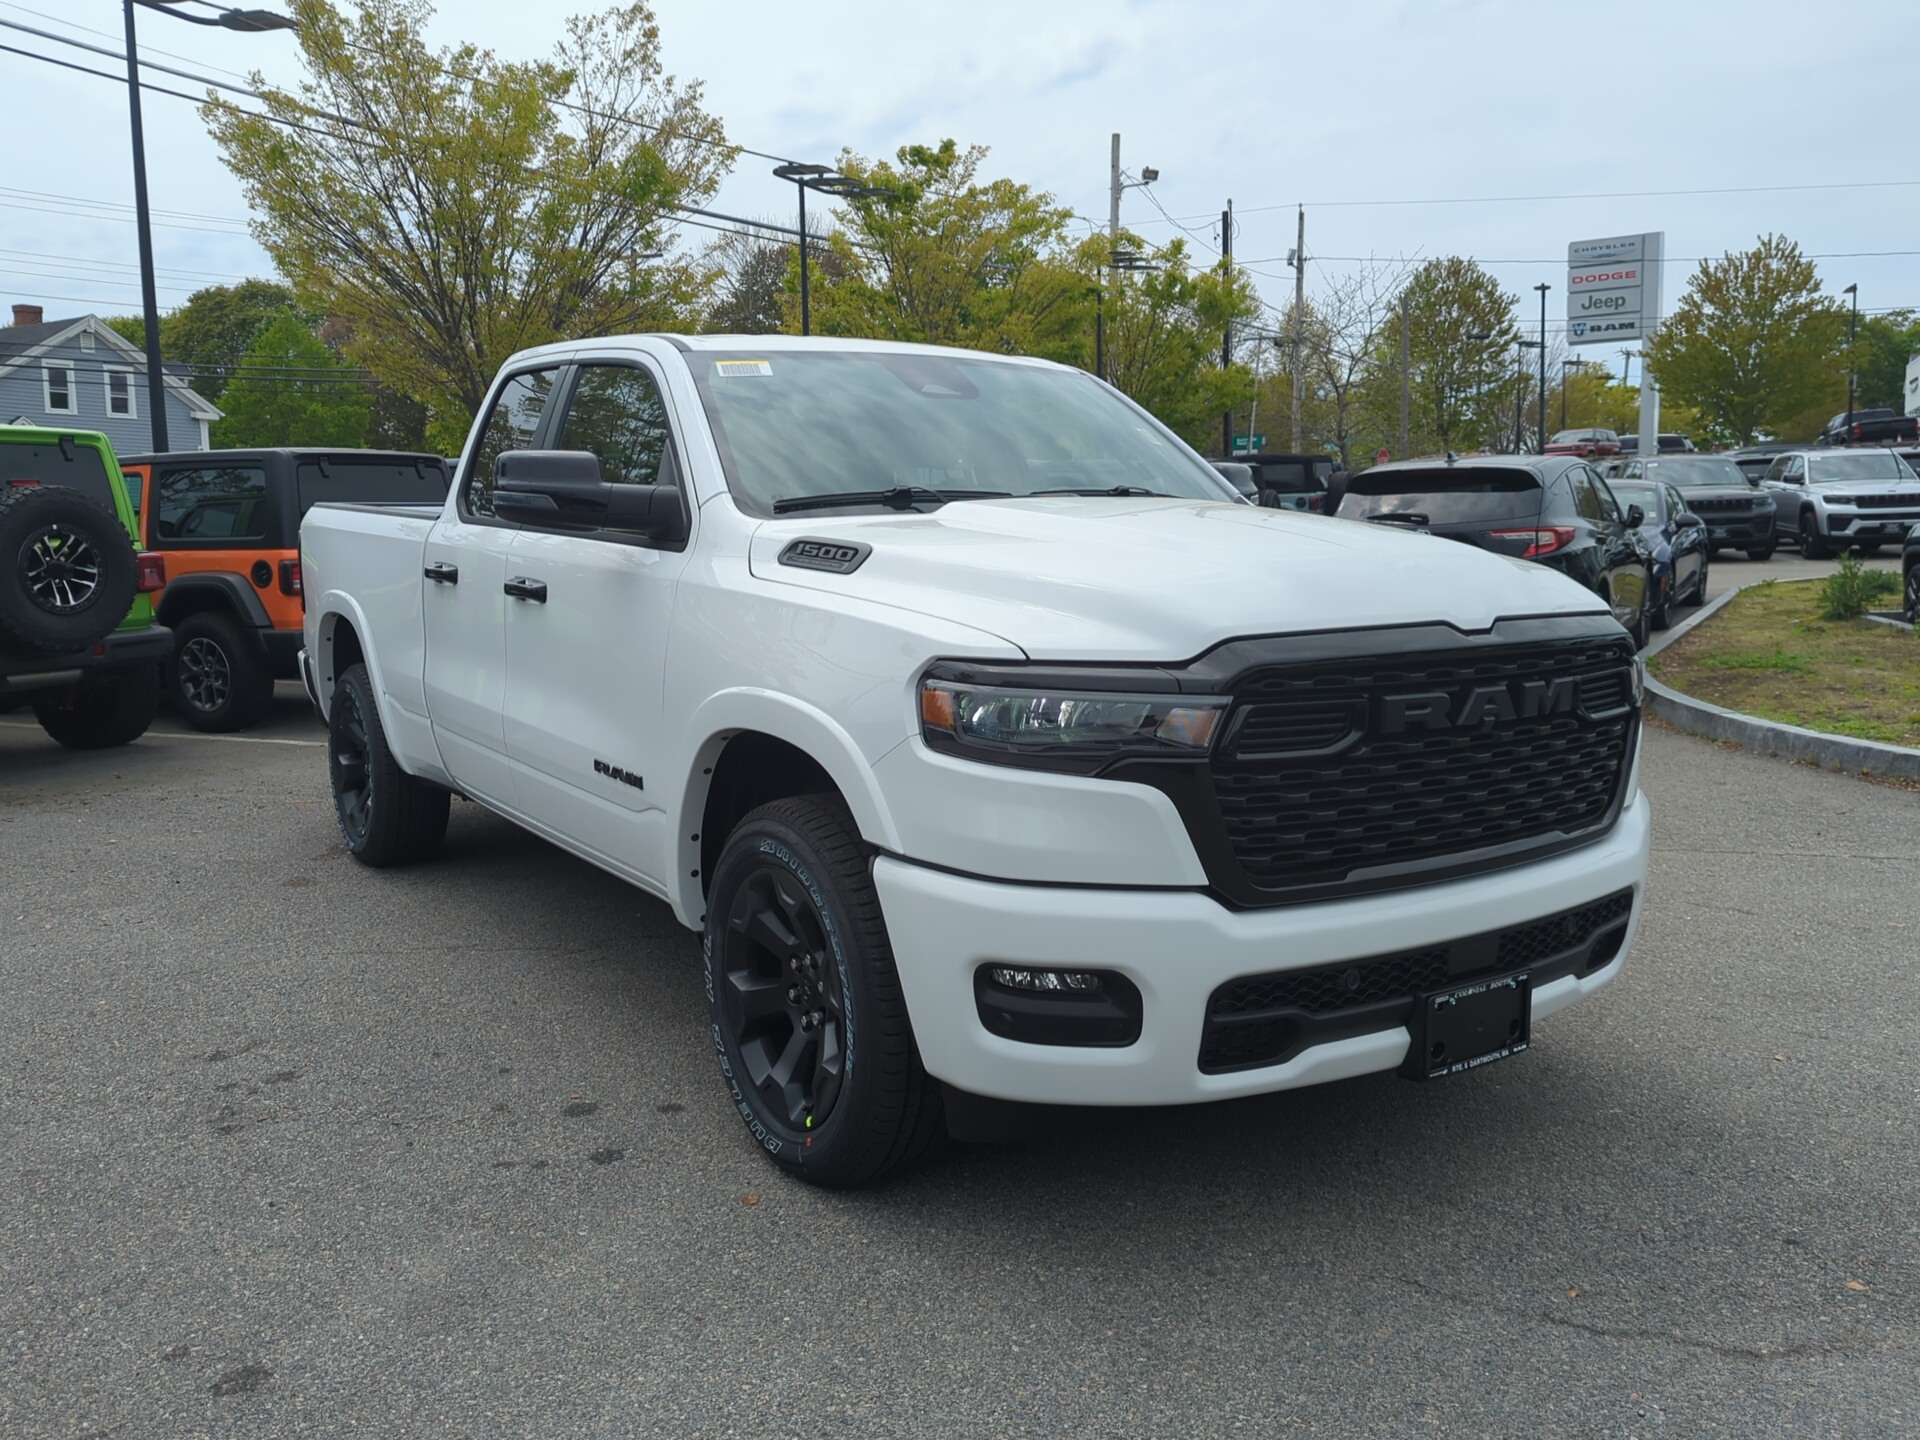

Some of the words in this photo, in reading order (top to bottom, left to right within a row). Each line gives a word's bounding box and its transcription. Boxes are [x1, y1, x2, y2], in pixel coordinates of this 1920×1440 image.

[1574, 242, 1636, 253] CHRYSLER
[1571, 270, 1637, 285] DODGE
[1581, 295, 1626, 310] Jeep
[1589, 322, 1635, 333] RAM
[795, 543, 855, 561] 1500
[1380, 676, 1575, 734] RAM
[593, 758, 644, 791] RAM
[712, 1023, 784, 1154] DUELER
